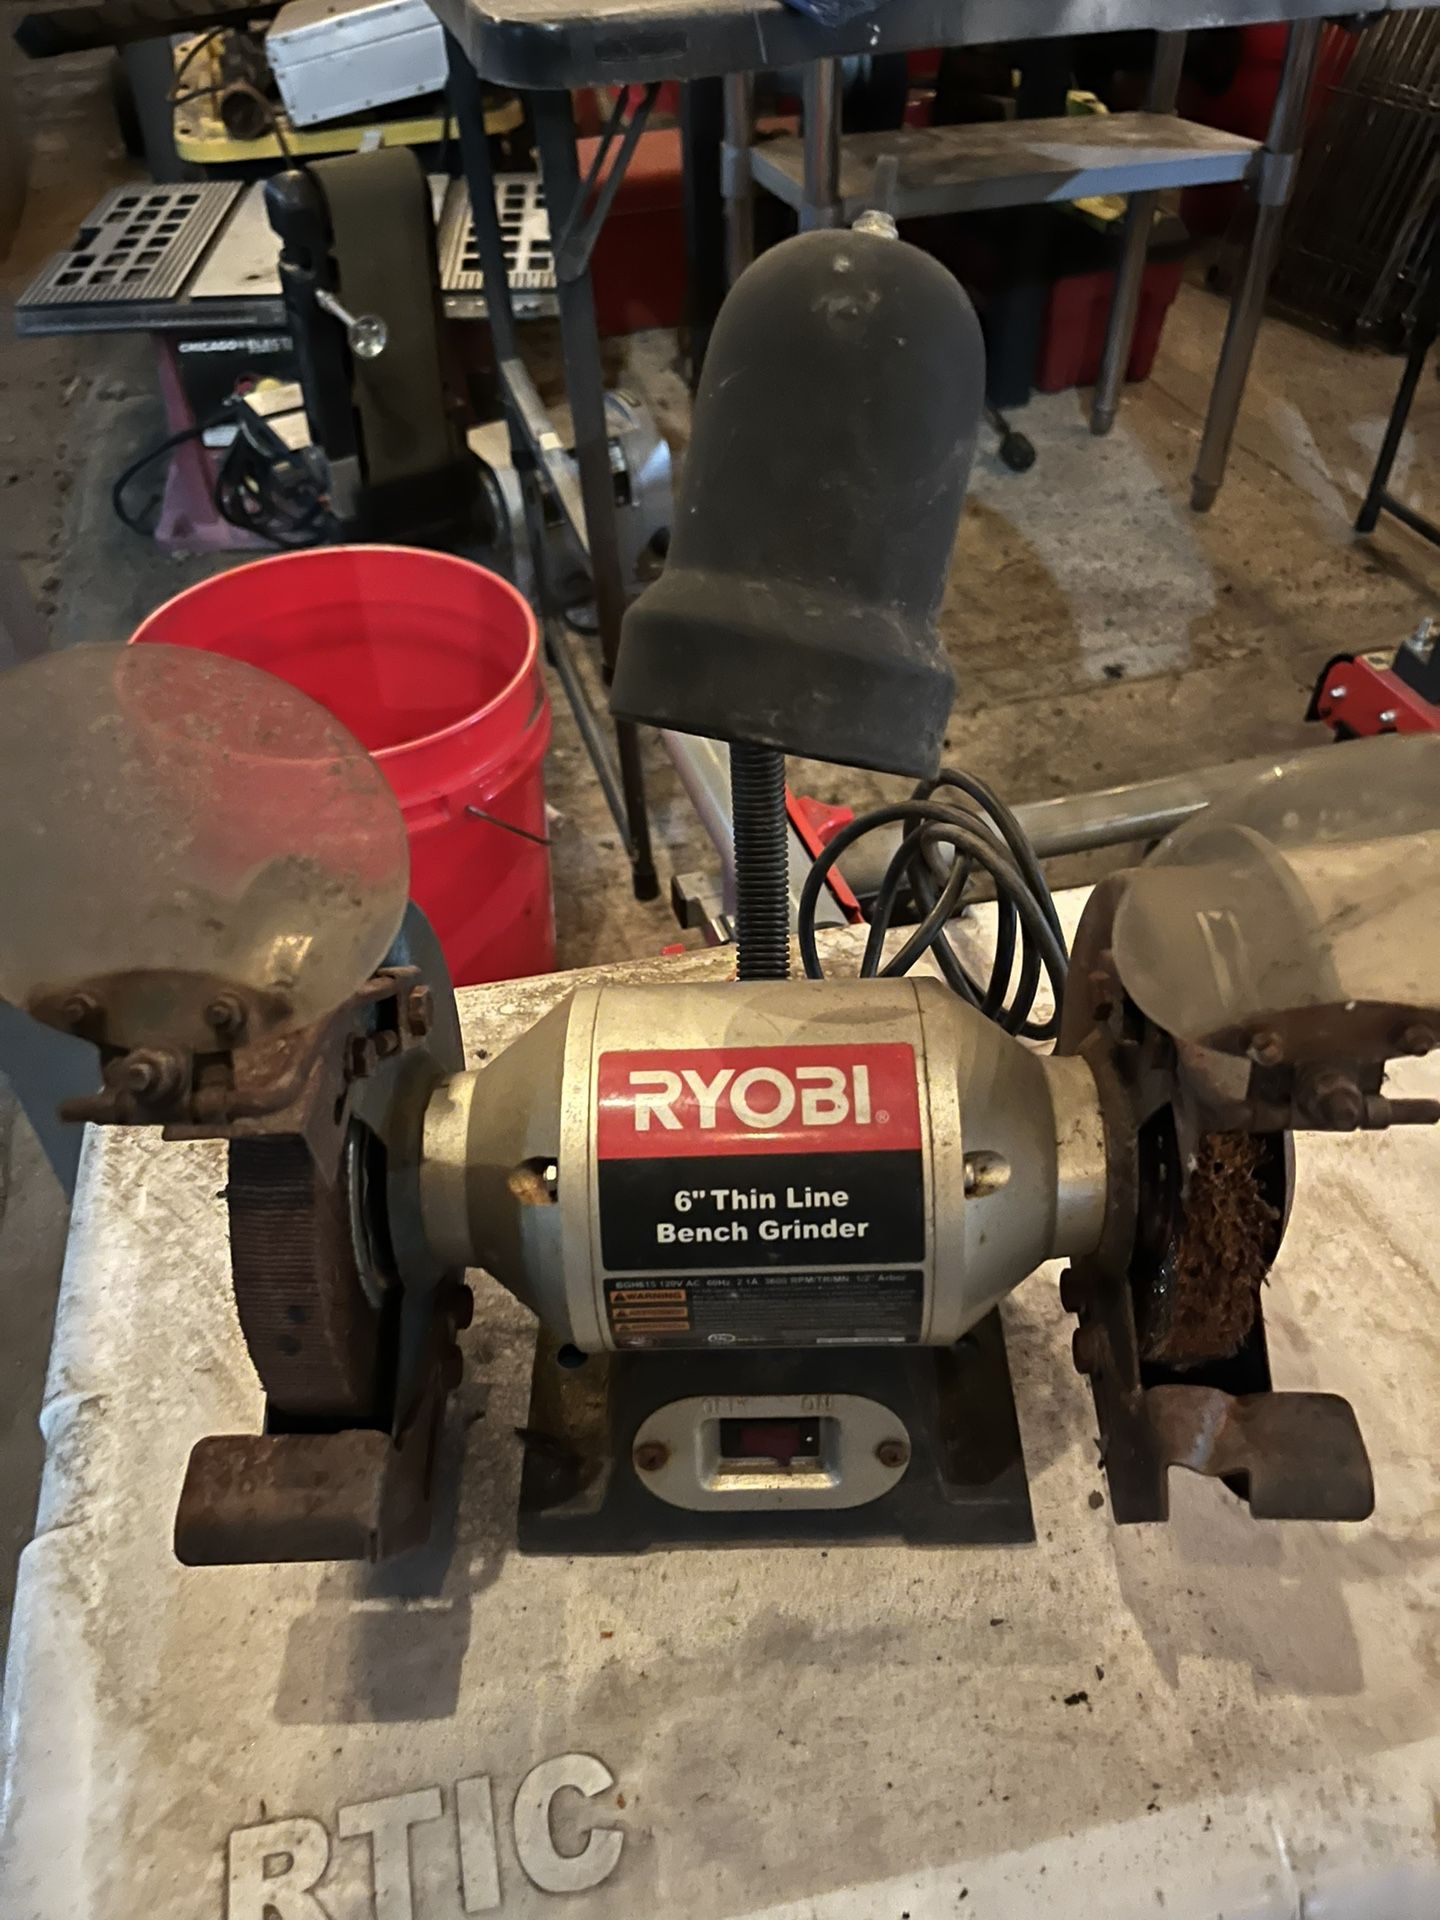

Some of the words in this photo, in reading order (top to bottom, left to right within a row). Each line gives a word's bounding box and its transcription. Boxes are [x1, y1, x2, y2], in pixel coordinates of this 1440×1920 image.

[178, 340, 238, 352] CHICAGO
[629, 1064, 871, 1131] RYOBI
[674, 1189, 706, 1212] 6"
[710, 1188, 776, 1211] Thin
[786, 1186, 849, 1209] Line
[656, 1222, 748, 1244] Bench
[758, 1218, 869, 1241] Grinder
[660, 1280, 684, 1288] 120V
[706, 1279, 730, 1287] 60Hz
[878, 1274, 907, 1282] Arbor
[627, 1292, 682, 1300] WARNING
[227, 1751, 625, 1920] RTIC
